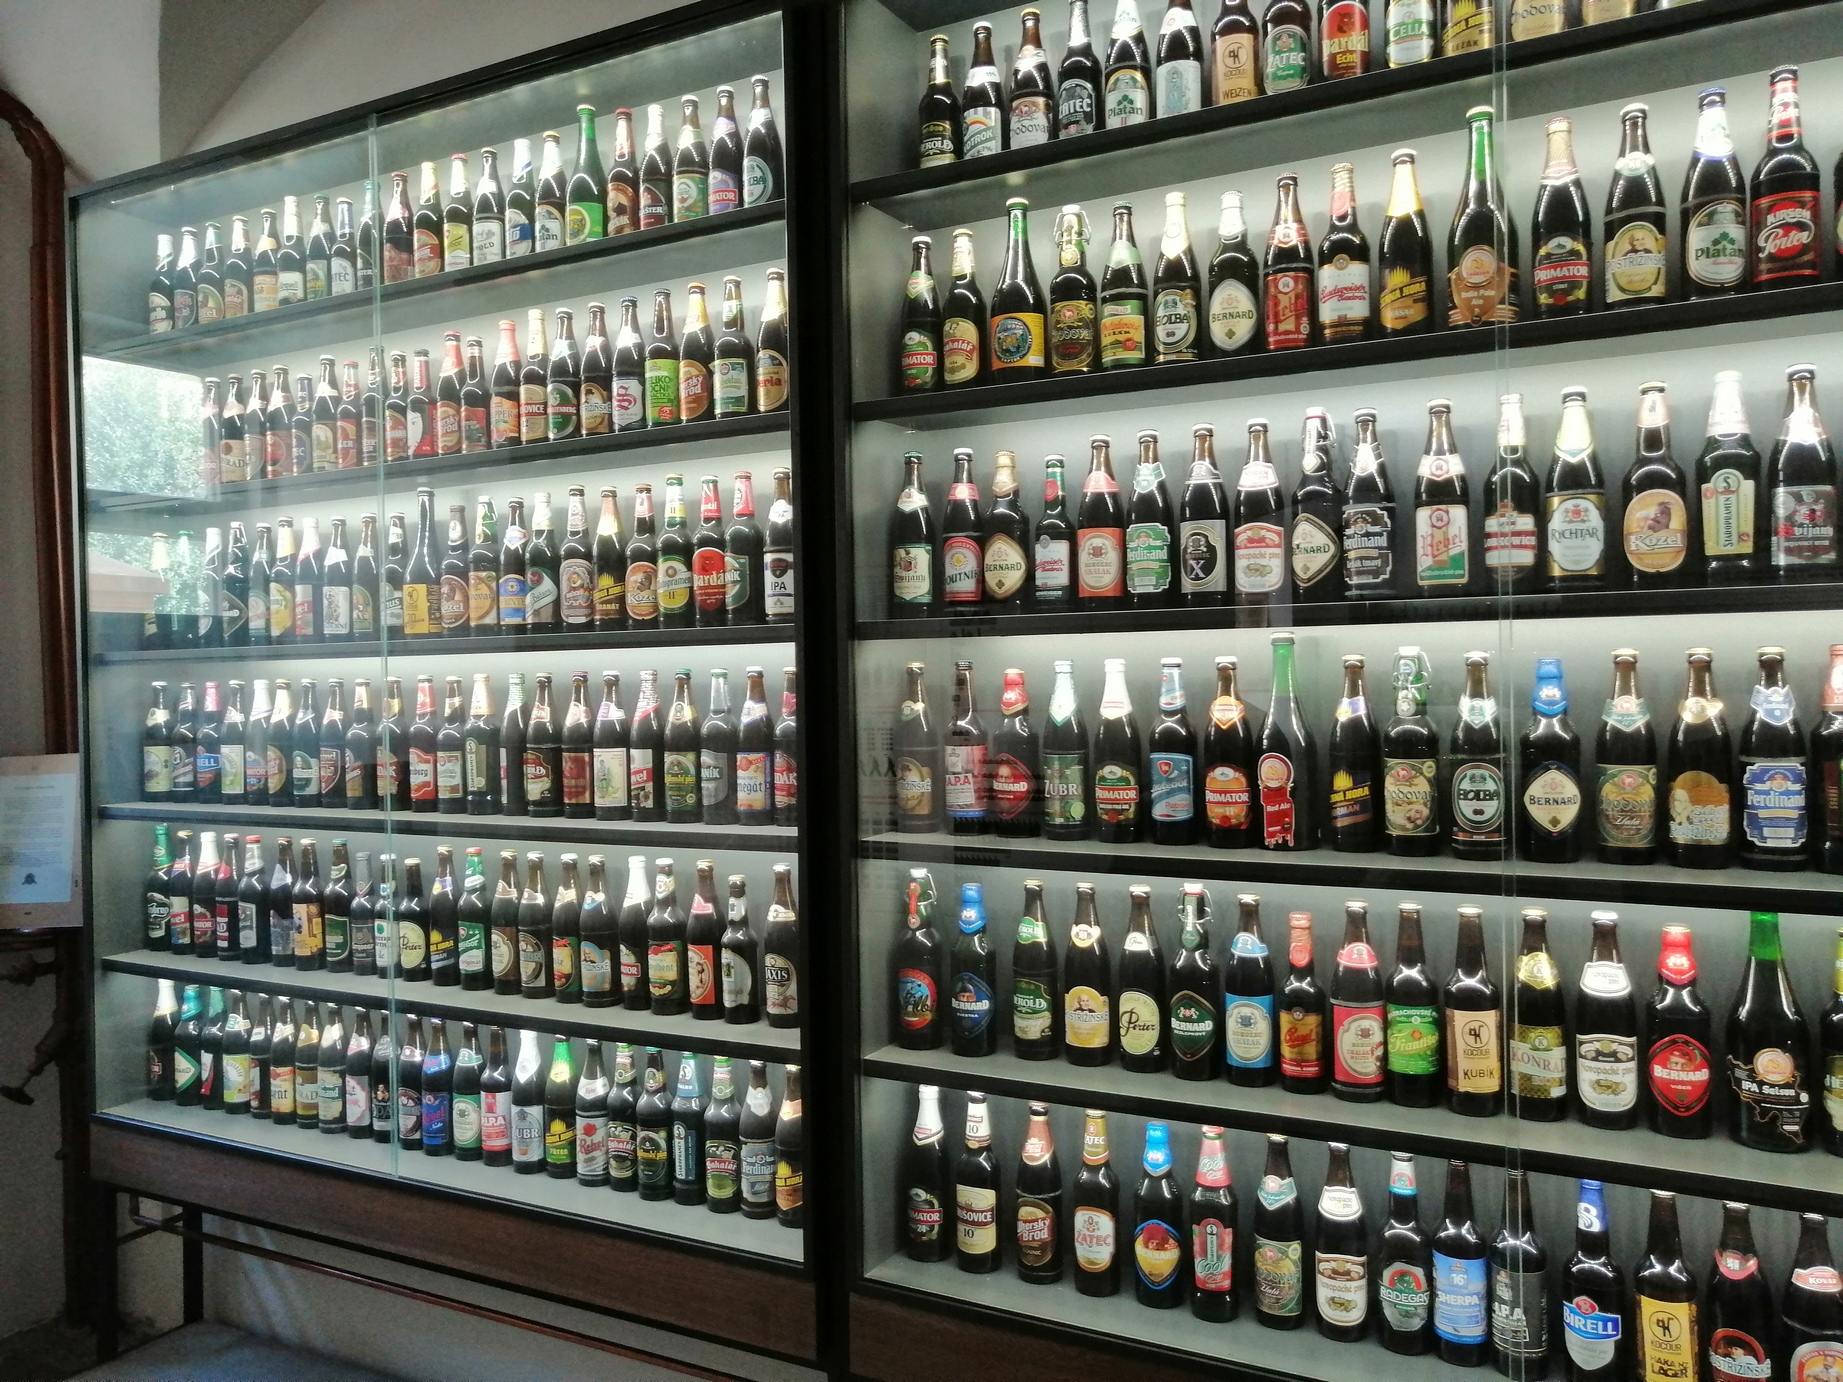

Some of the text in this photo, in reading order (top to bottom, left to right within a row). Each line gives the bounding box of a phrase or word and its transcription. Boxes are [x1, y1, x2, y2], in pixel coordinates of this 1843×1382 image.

[1390, 22, 1429, 40] CELIA
[1336, 52, 1357, 64] Echt
[1108, 105, 1143, 119] Platan
[920, 139, 954, 154] EROLD
[1756, 226, 1814, 260] Porter
[1534, 265, 1590, 283] PRIMATOR
[1156, 312, 1192, 327] HOLBA
[1211, 308, 1255, 322] BERNARD
[902, 354, 934, 368] IMATOR
[1723, 495, 1734, 549] STAROPRAMEN
[1343, 534, 1388, 551] Ferdinand
[1421, 532, 1463, 559] Rebel
[1629, 532, 1684, 553] Kozel
[985, 561, 1022, 573] BERNARD
[1190, 560, 1205, 578] X
[770, 581, 787, 591] IPA
[775, 772, 797, 784] DÁK
[992, 780, 1028, 792] BERNARD
[1044, 780, 1078, 797] ZUBR
[1345, 786, 1369, 799] HORA
[1095, 787, 1137, 801] PRIMATOR
[1205, 790, 1250, 803] PRIMATOR
[1458, 788, 1499, 801] HOLBA
[1529, 793, 1578, 806] BERNARD
[1746, 789, 1805, 808] Ferdinand
[952, 998, 990, 1011] BERNARD
[1120, 1007, 1156, 1037] Porter
[1170, 1017, 1213, 1031] BERNARD
[1538, 1038, 1545, 1047] K
[1463, 1065, 1495, 1081] KUBÍK
[1654, 1065, 1709, 1080] BERNARD
[1741, 1080, 1760, 1093] IPA
[743, 1162, 773, 1174] Ferdinan
[1021, 1226, 1049, 1241] Brod
[1437, 1291, 1480, 1306] SHERPA
[1563, 1303, 1617, 1335] BIRELL
[1652, 1365, 1689, 1379] LAGER
